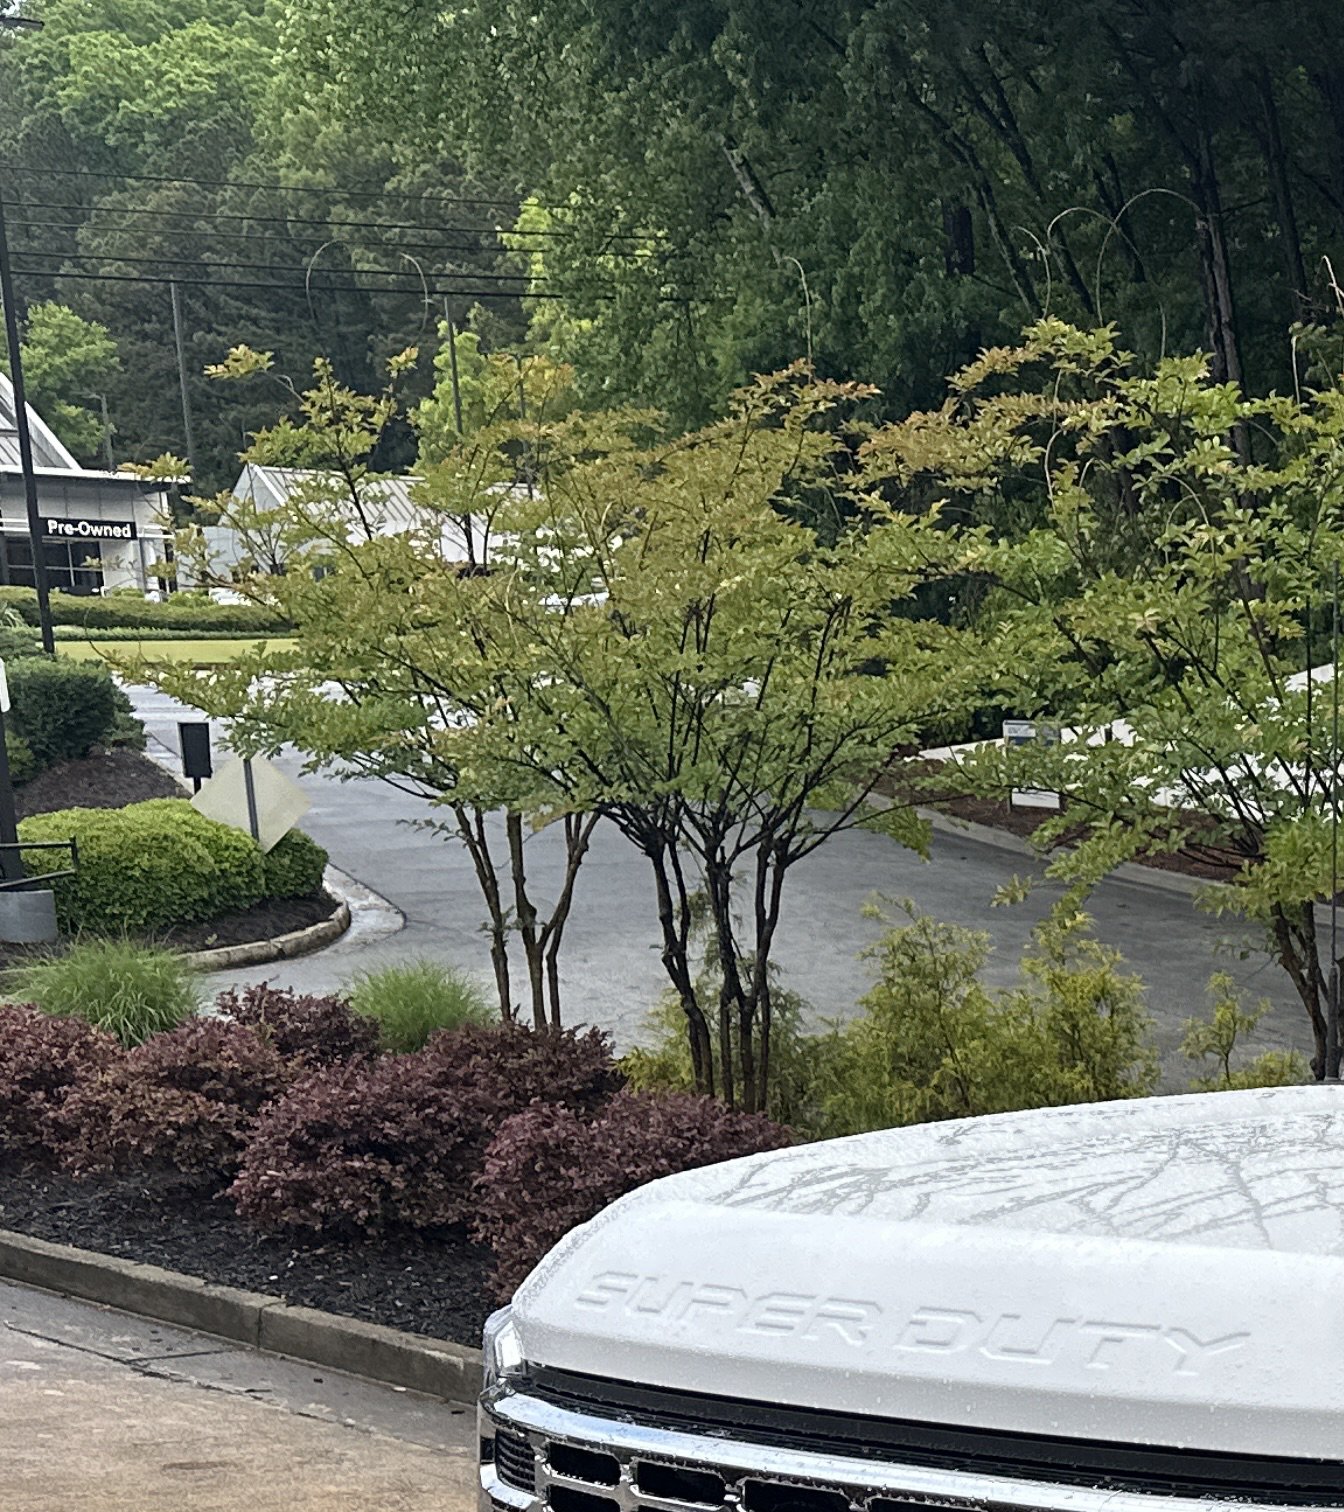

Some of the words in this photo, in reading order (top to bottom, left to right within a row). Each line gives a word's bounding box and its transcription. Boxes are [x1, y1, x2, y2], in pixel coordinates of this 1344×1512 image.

[47, 519, 131, 538] Pre-Owned
[574, 1270, 884, 1346] SUPER
[895, 1305, 1252, 1376] DUTY
